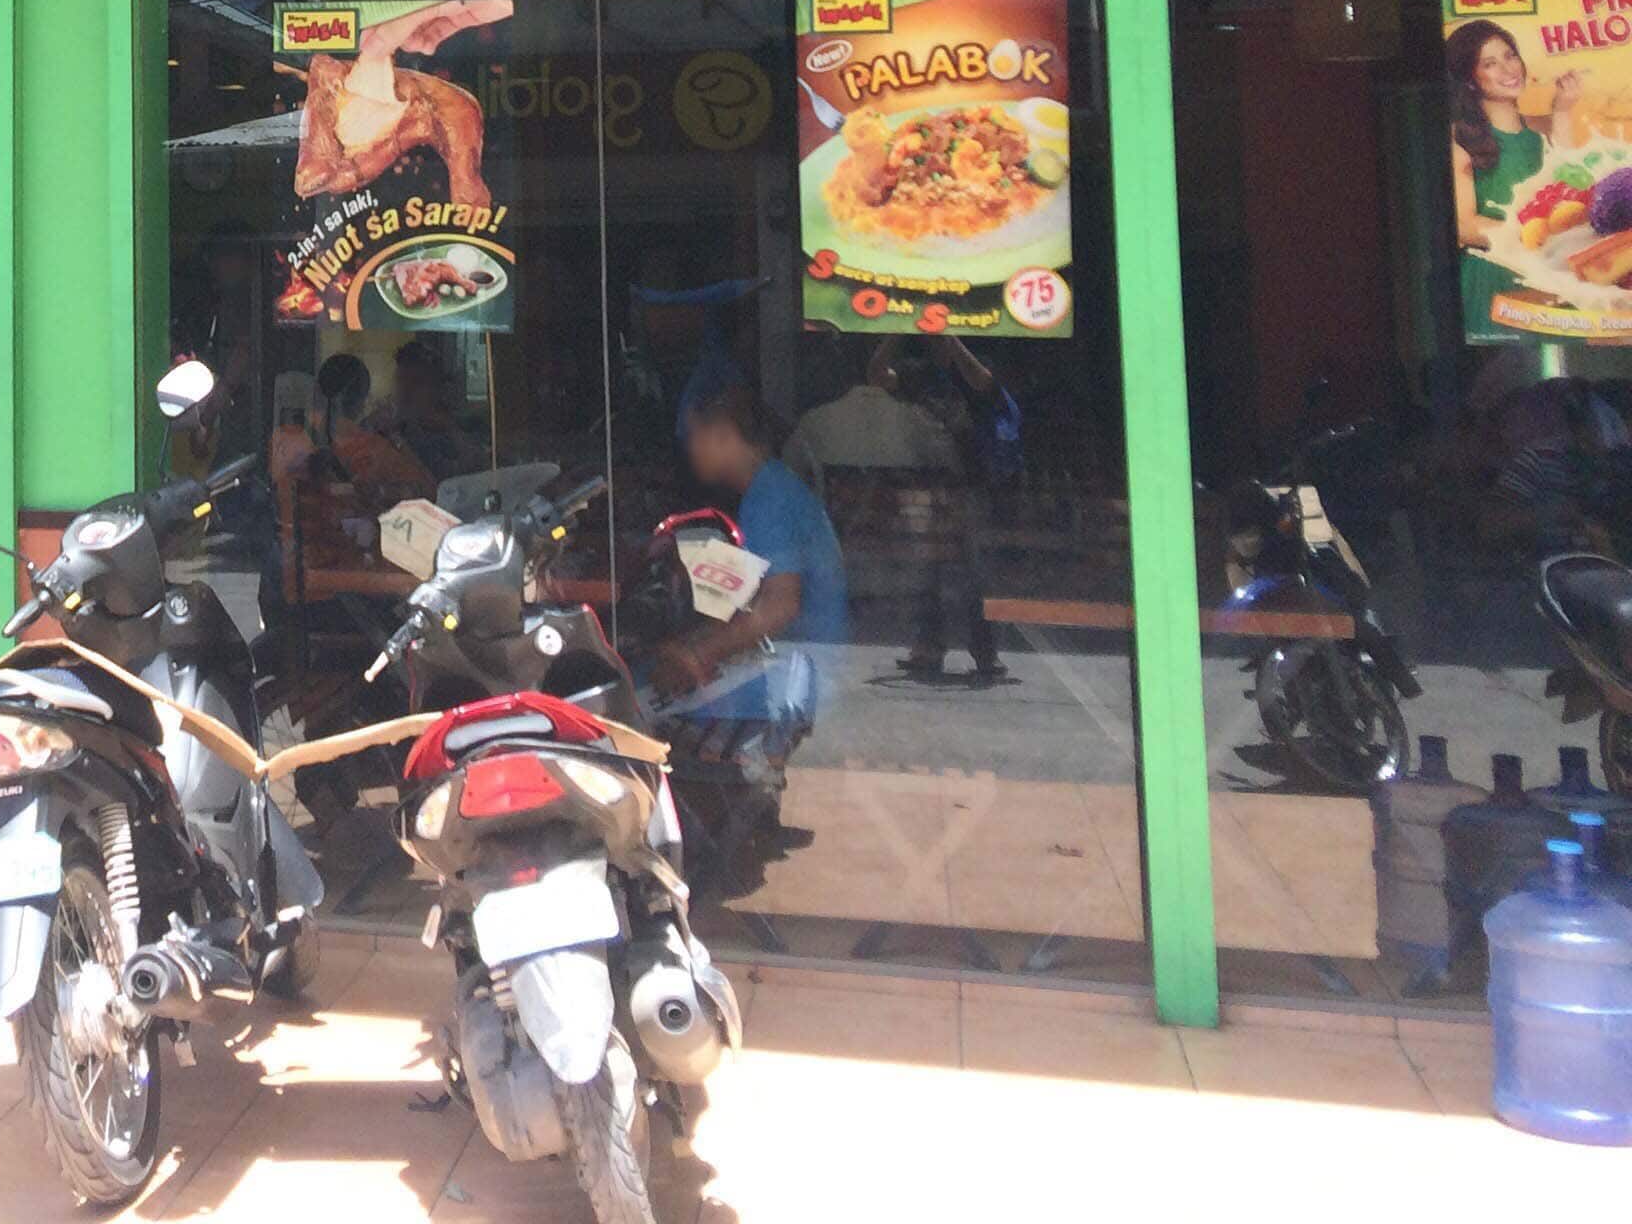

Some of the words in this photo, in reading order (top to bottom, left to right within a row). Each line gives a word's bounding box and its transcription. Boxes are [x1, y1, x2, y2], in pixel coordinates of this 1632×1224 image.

[841, 39, 1052, 100] PALABOK
[303, 228, 364, 292] Nuot
[367, 208, 400, 240] sa
[404, 196, 508, 234] Sarap!
[324, 213, 343, 233] sa
